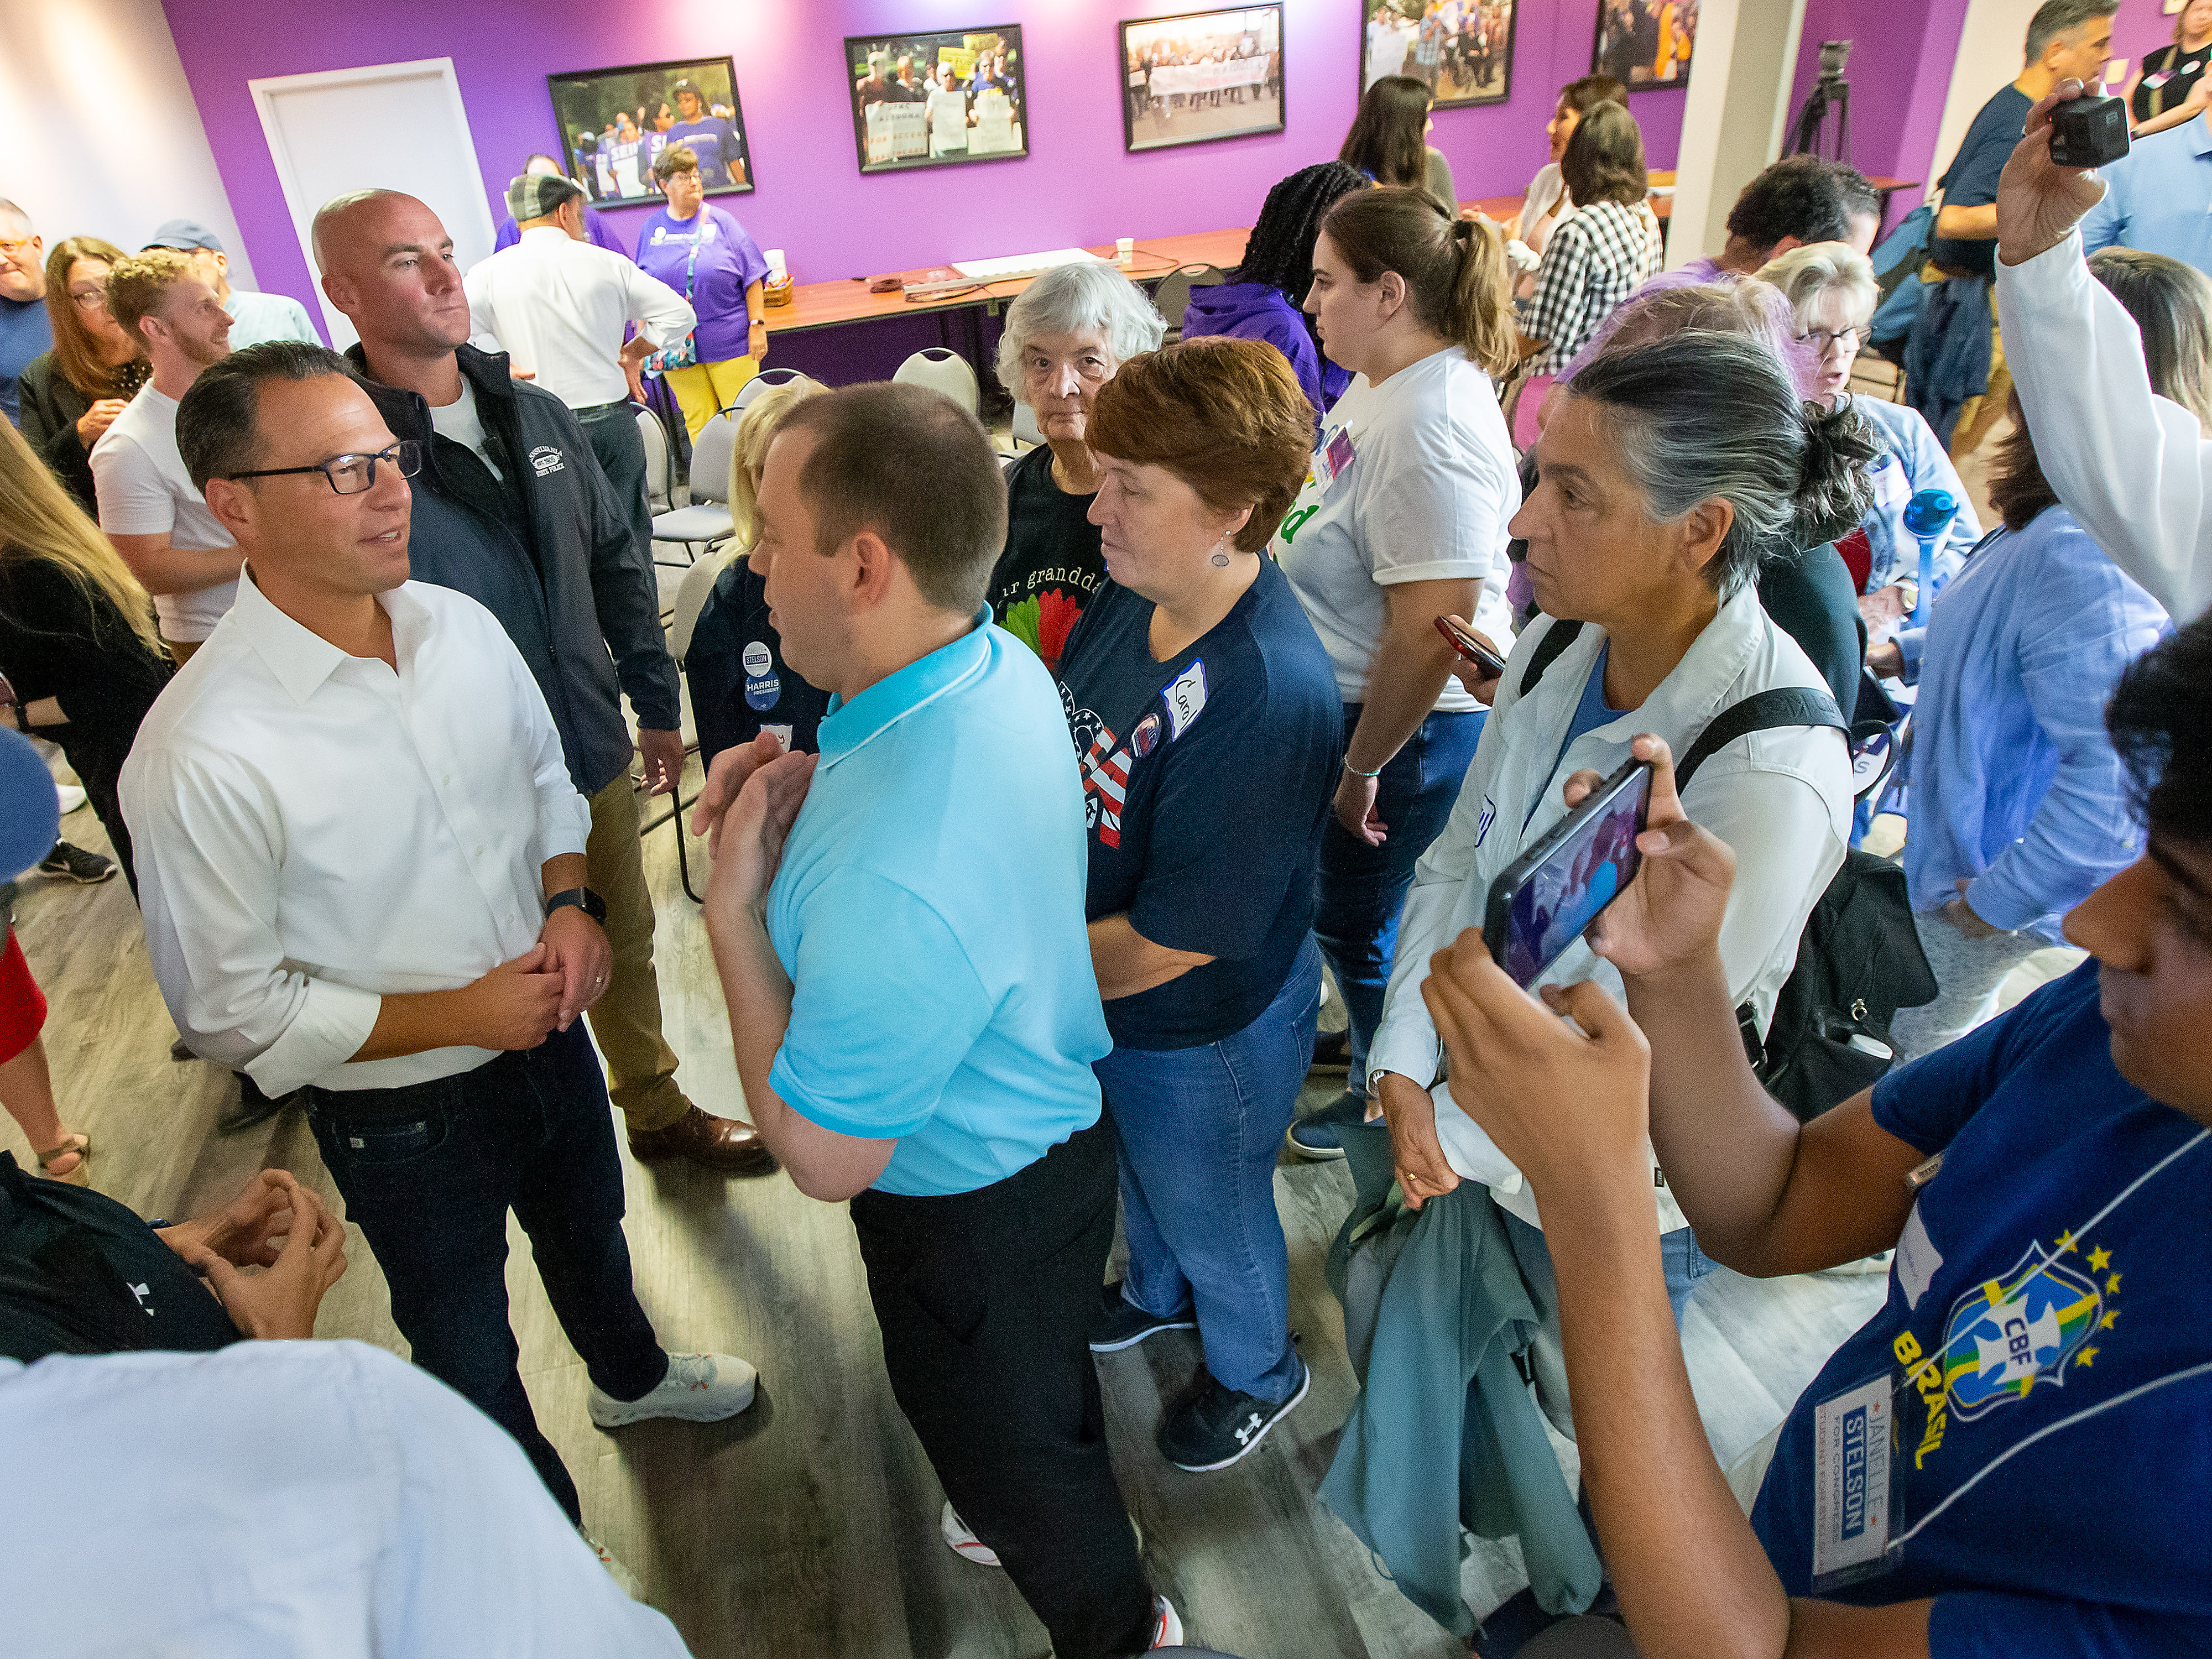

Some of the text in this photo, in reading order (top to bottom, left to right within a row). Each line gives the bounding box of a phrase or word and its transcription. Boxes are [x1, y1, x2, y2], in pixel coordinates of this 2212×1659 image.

[746, 655, 767, 664] STELSON
[747, 679, 779, 692] HARRIS
[1175, 680, 1198, 732] Carol
[2005, 1318, 2032, 1364] CBF
[1893, 1330, 1947, 1470] BRASIL
[1846, 1416, 1864, 1531] STELSON
[1868, 1415, 1885, 1510] JANELLE
[1832, 1453, 1841, 1544] CONGRESS
